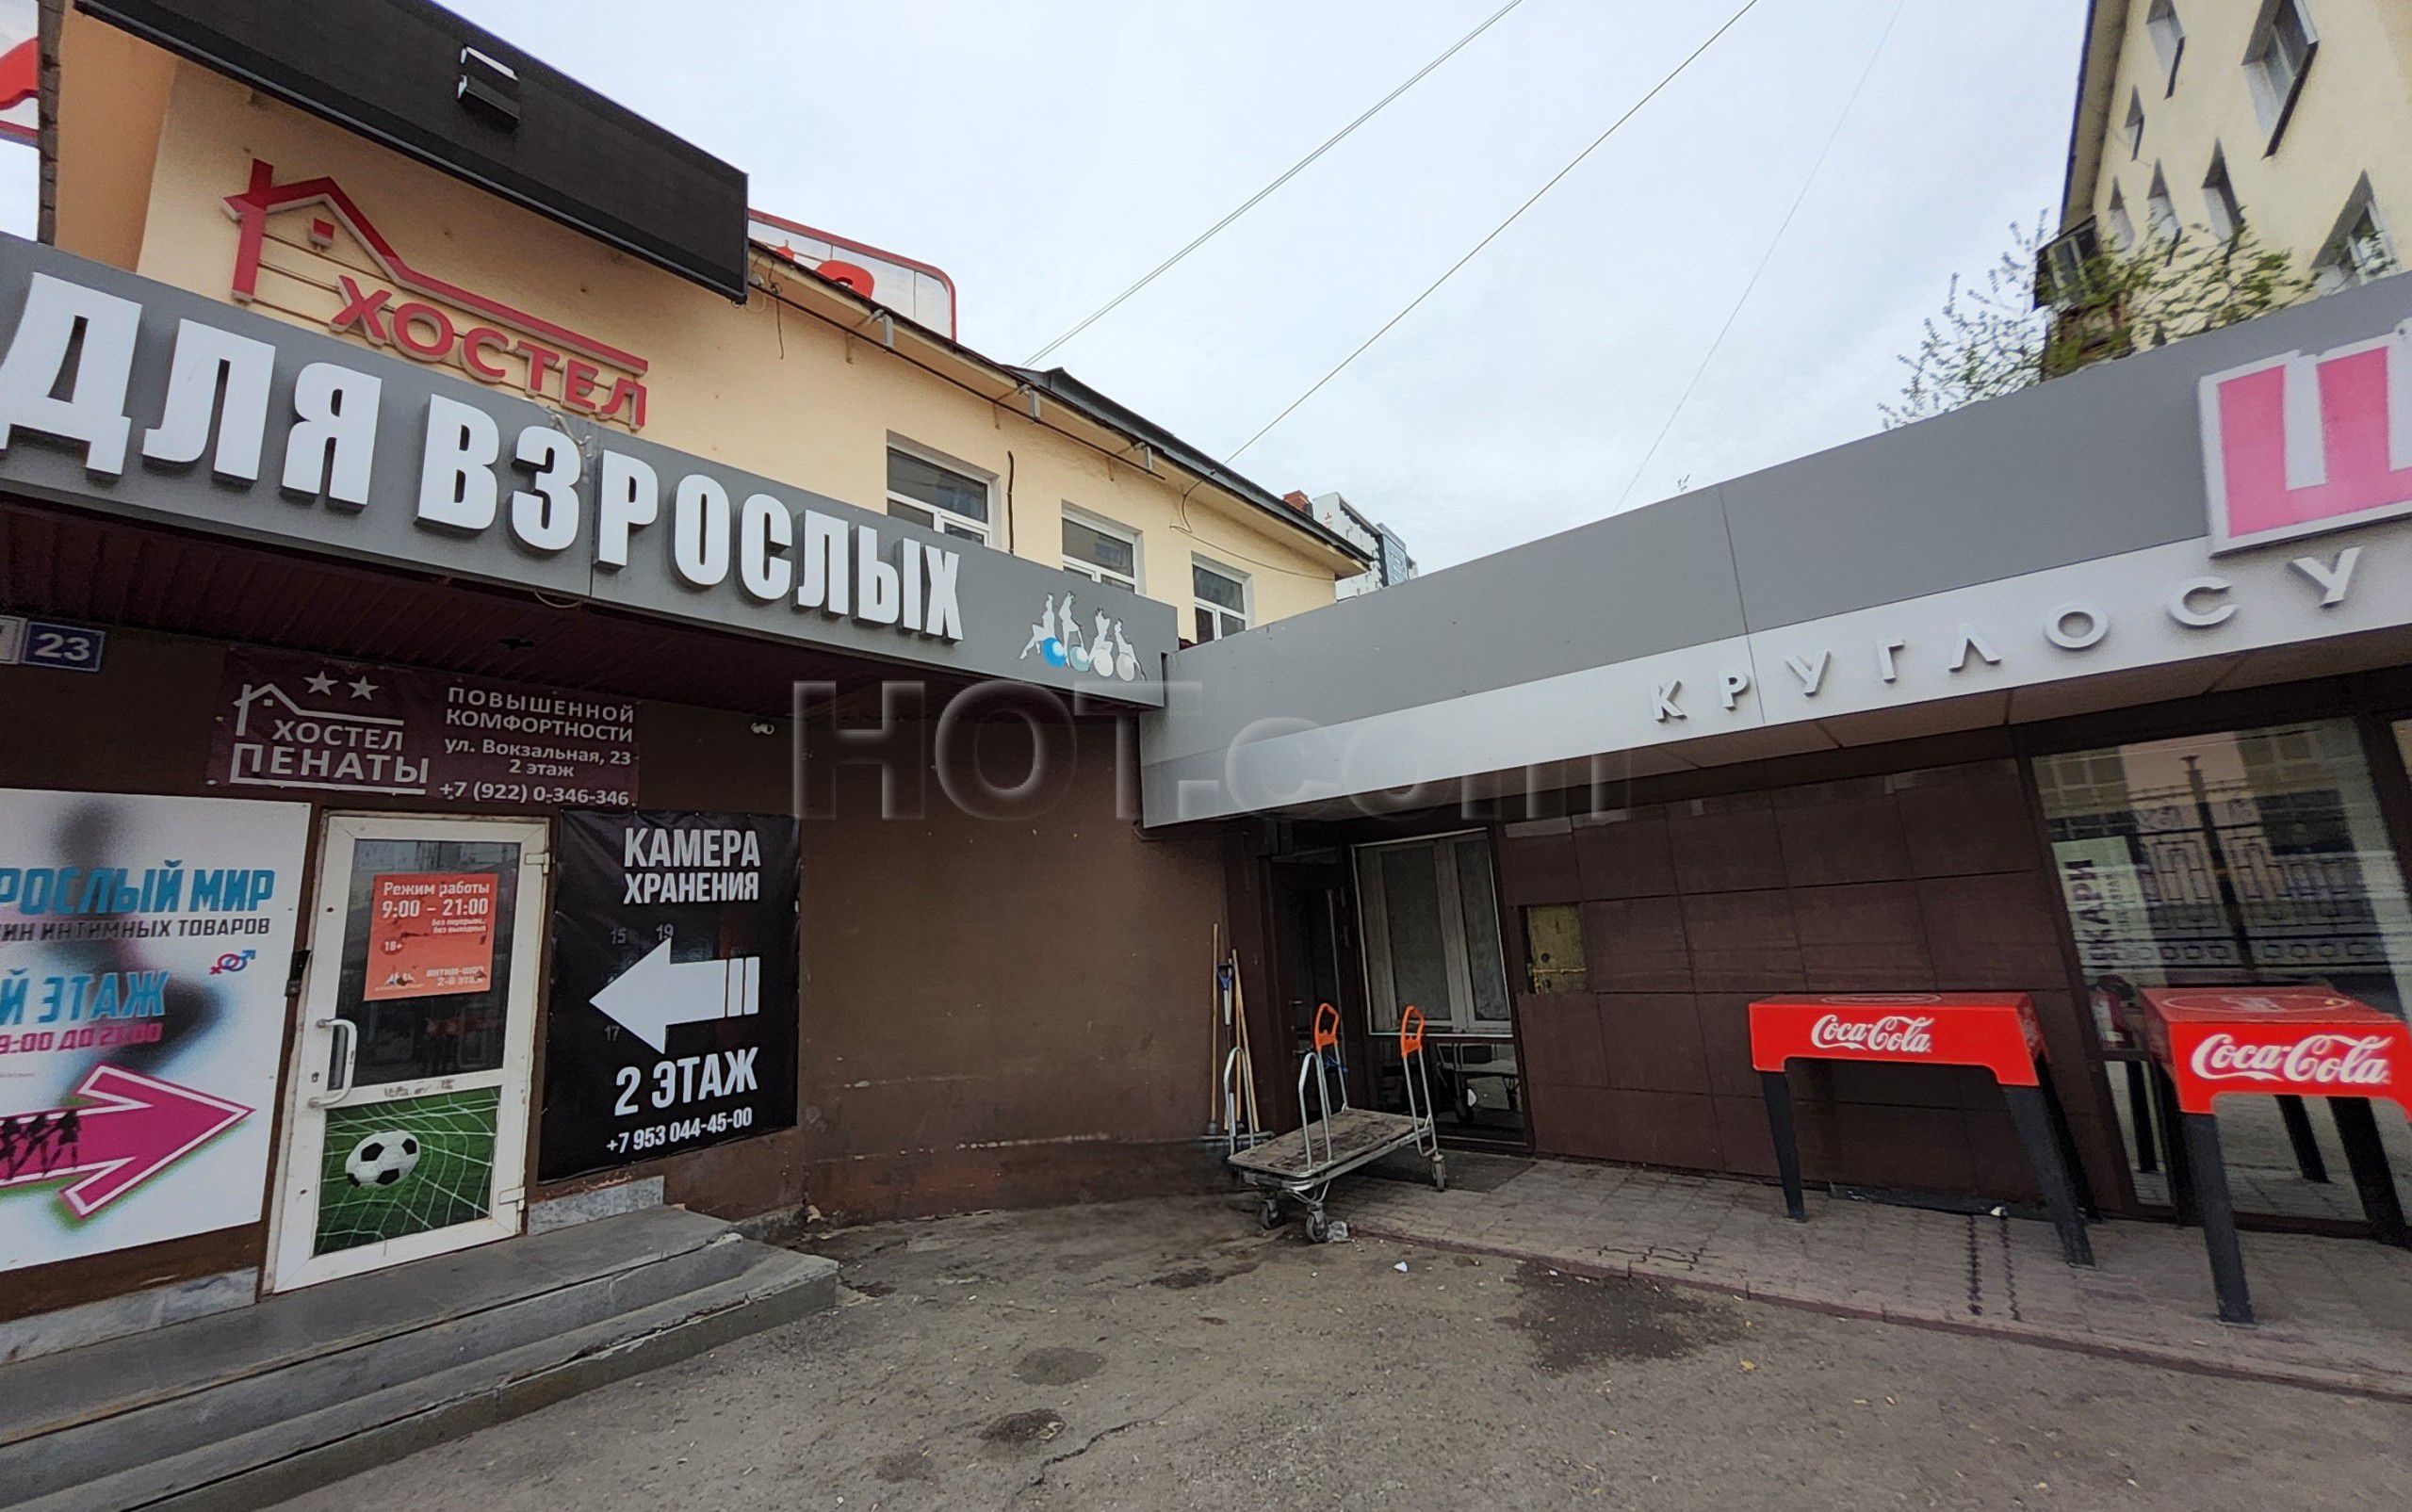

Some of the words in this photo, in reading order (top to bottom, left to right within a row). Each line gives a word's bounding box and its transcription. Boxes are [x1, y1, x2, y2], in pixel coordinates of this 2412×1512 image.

[330, 274, 647, 431] ХОСТЕЛ
[0, 272, 383, 506] ДЛЯ
[416, 394, 964, 642] ВЗРОСЛЫХ
[35, 632, 90, 661] 23
[448, 687, 634, 723] ПОВЫШЕННОЙ
[271, 719, 403, 752] ХОСТЕЛ
[445, 708, 633, 743] КОМФОРТНОСТИ
[230, 742, 430, 784] ПЕНАТЫ
[445, 738, 476, 754] ул.
[481, 739, 606, 766] Вокзальная,
[610, 751, 631, 765] 23
[509, 758, 522, 773] 2
[526, 762, 575, 778] этаж
[439, 781, 467, 798] +7
[473, 781, 528, 803] (922)
[533, 786, 629, 806] 0-346-346
[624, 827, 761, 868] КАМЕРА
[188, 869, 275, 913] МИР
[383, 881, 435, 896] Режим
[439, 880, 490, 897] работы
[623, 871, 759, 904] ХРАНЕНИЯ
[382, 900, 420, 919] 9:00
[442, 898, 489, 917] 21:00
[40, 919, 173, 941] ИНТИМНЫХ
[177, 918, 271, 936] ТОВАРОВ
[384, 941, 403, 951] 18+
[38, 970, 171, 1024] ЭТАЖ
[57, 1028, 94, 1051] ДО
[1811, 1014, 1935, 1053] Coca-Cola
[2191, 1033, 2393, 1084] Coca-Cola
[613, 1066, 642, 1116] 2
[651, 1047, 758, 1109] ЭТАЖ
[606, 1131, 629, 1154] +7
[632, 1125, 666, 1150] 953
[669, 1106, 753, 1143] 044-45-00
